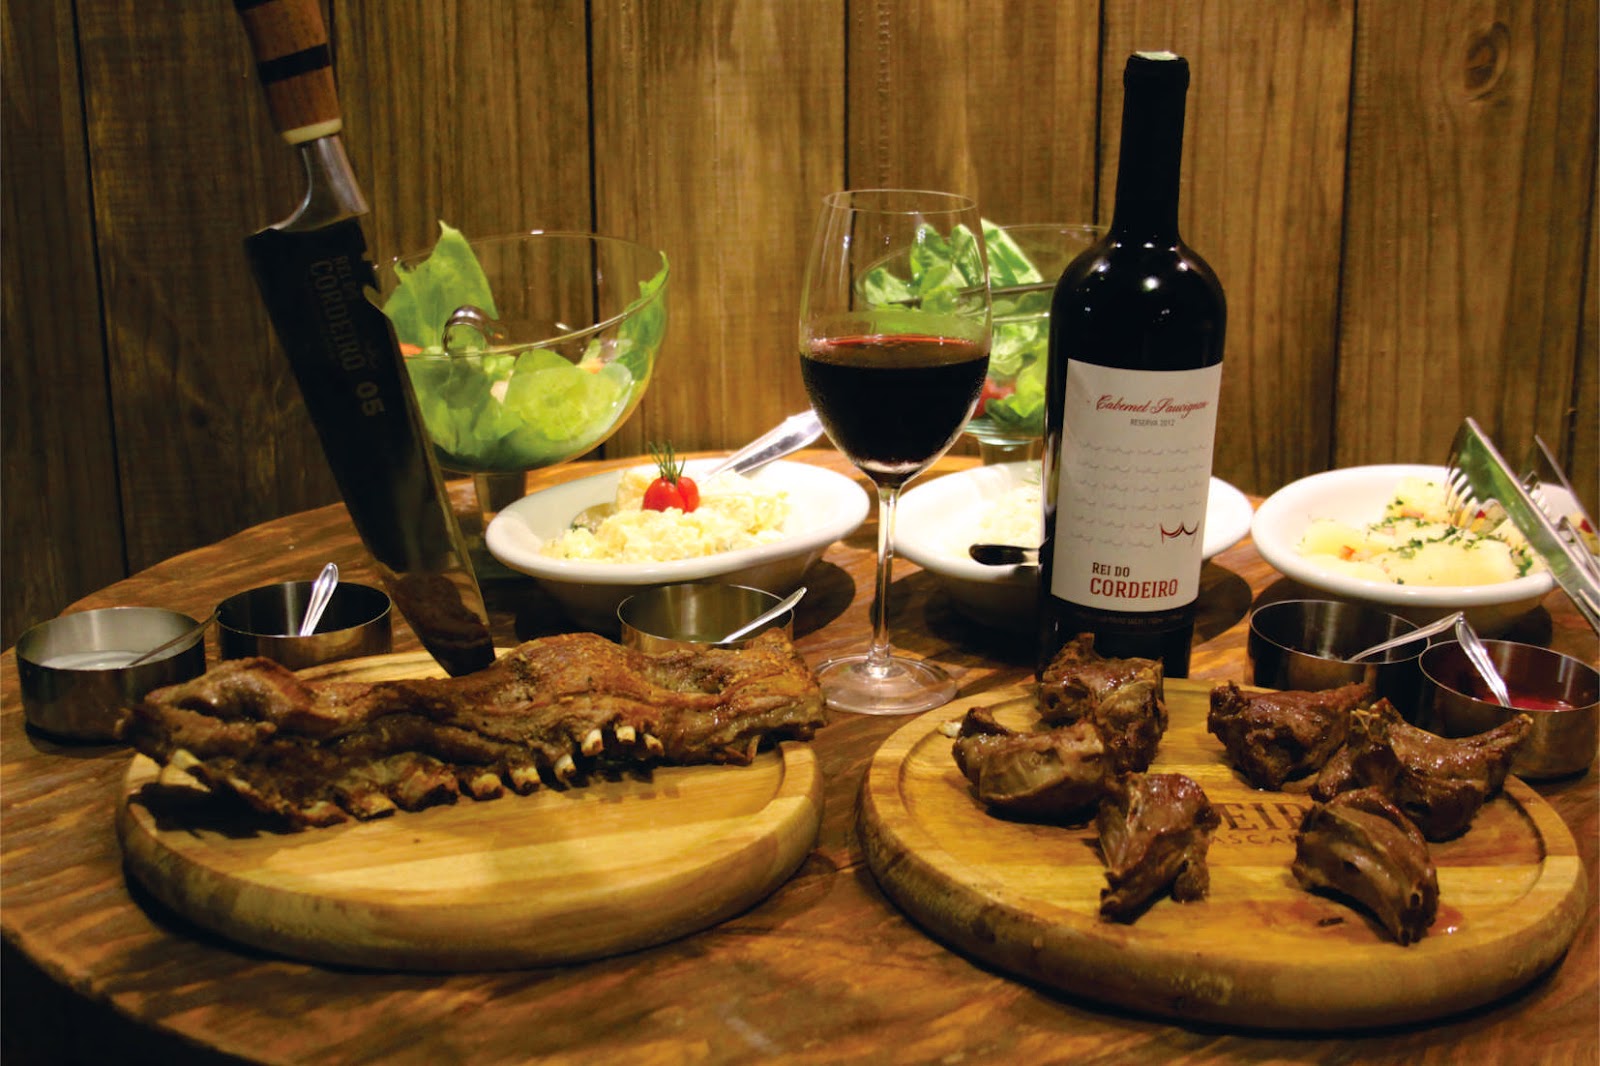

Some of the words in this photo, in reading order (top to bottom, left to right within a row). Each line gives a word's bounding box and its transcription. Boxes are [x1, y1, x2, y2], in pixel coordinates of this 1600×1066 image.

[310, 259, 367, 372] CORDEIRO
[355, 380, 386, 417] 05
[1095, 394, 1151, 413] Cabernet
[1129, 418, 1159, 427] RESERVA
[1091, 561, 1112, 577] REI
[1114, 565, 1131, 578] DO
[1089, 577, 1179, 599] CORDEIRO
